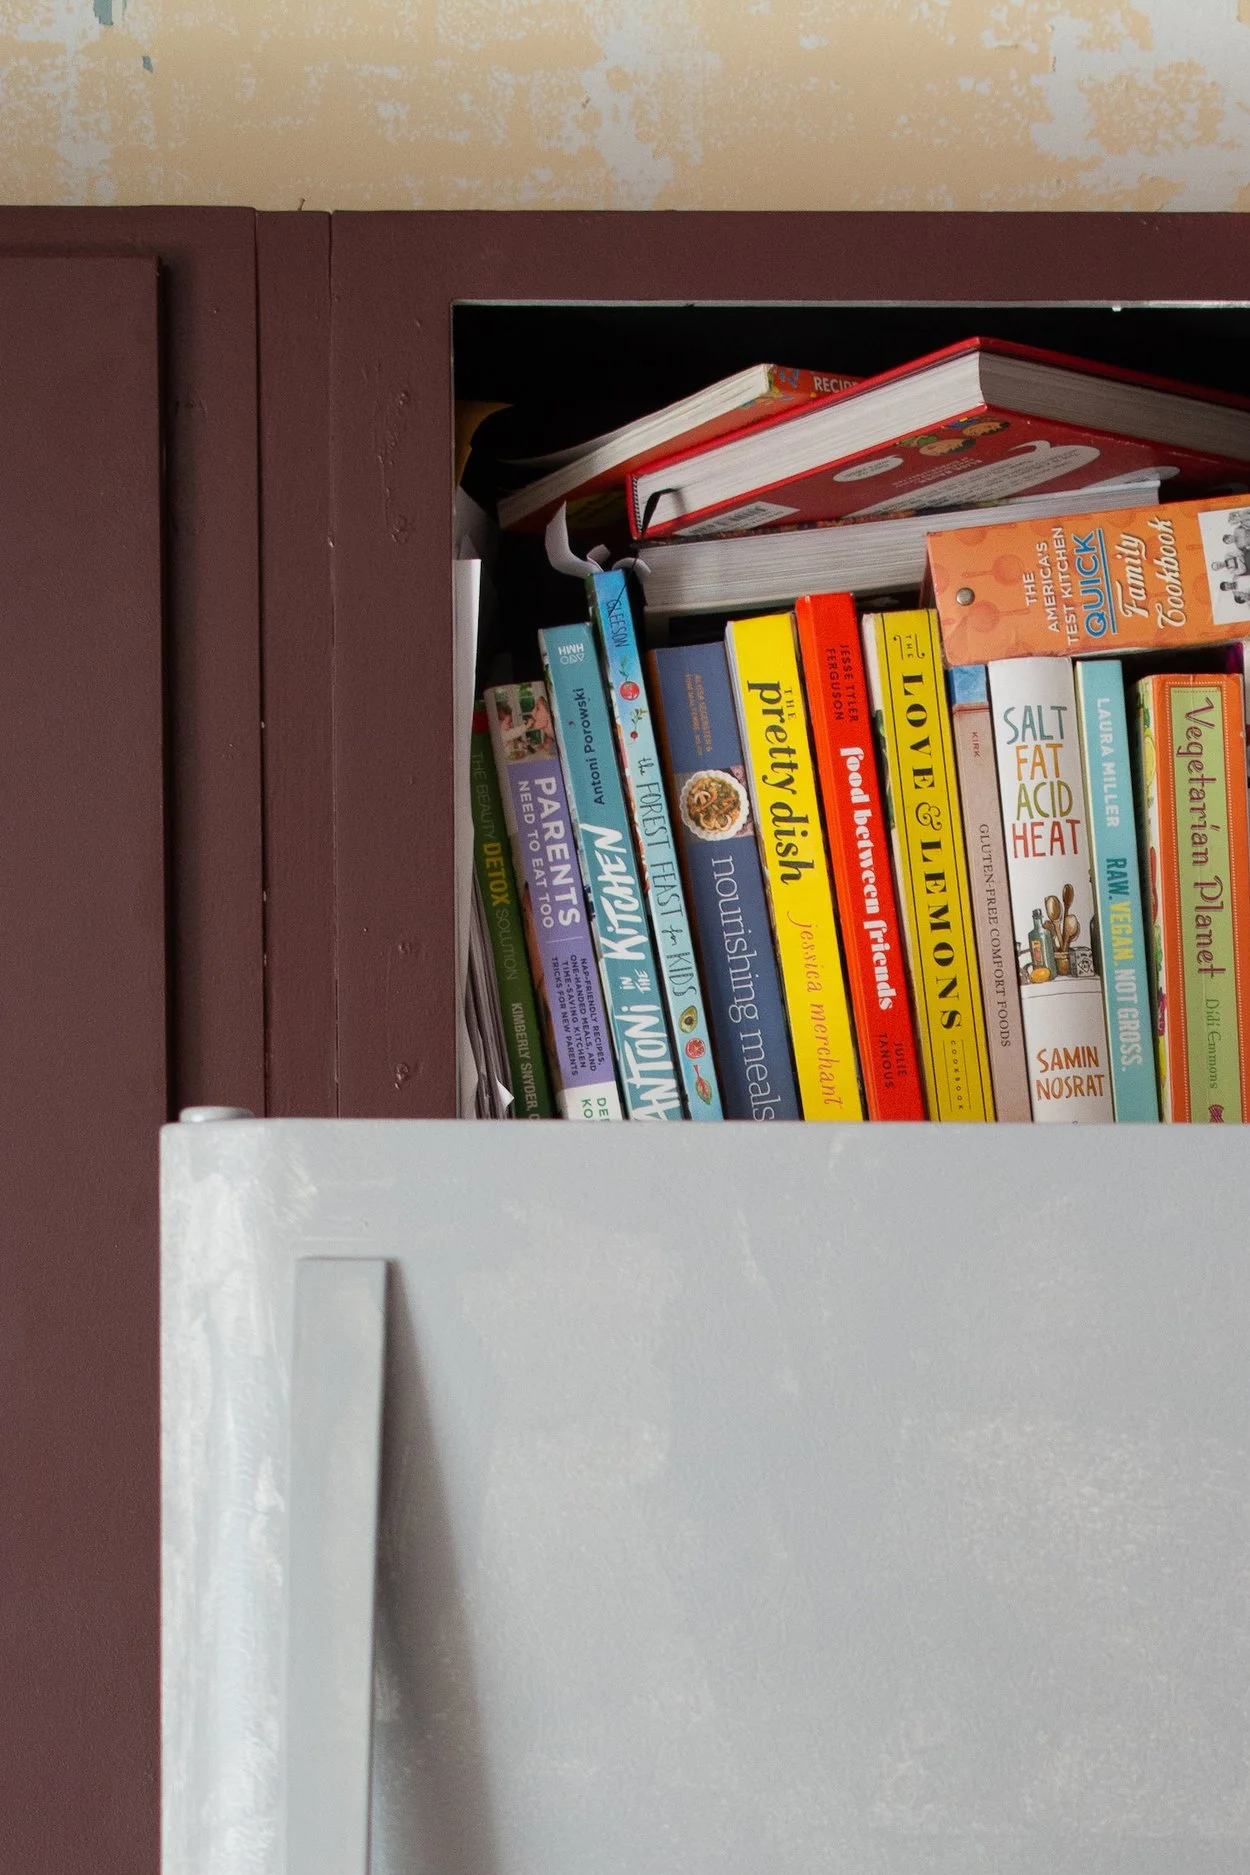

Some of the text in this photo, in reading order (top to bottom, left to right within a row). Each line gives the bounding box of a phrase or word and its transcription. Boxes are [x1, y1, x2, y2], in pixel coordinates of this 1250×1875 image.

[1022, 571, 1038, 607] THE
[1036, 540, 1060, 633] AMERICA'S
[1051, 526, 1080, 646] TEST KITCHEN
[1071, 531, 1109, 638] QUICK
[1115, 532, 1149, 619] Family
[1147, 516, 1187, 630] Cookbook
[558, 643, 585, 656] HMH
[606, 599, 630, 648] GLEESON
[905, 634, 914, 658] THE
[784, 687, 798, 720] THE
[825, 647, 844, 721] FERGUSON
[840, 644, 860, 722] JESSE TYLER
[1003, 705, 1068, 745] SALT
[572, 687, 605, 805] Antoni Porowski
[746, 680, 815, 885] pretty dish
[971, 731, 981, 758] KIRK
[1015, 743, 1064, 781] FAT
[1096, 697, 1121, 828] LAURA MILLER
[1012, 819, 1081, 859] HEAT
[1016, 780, 1073, 821] ACID
[1176, 696, 1227, 978] Vegetarian Planet
[471, 754, 518, 981] THE BEAUTY DETOX SOLUTION
[518, 780, 554, 929] NEED TO EAT TOO
[534, 776, 581, 926] PARENTS
[635, 758, 698, 997] the FOREST FEAST for KIDS
[839, 747, 898, 1010] food between friends
[902, 672, 963, 1030] LOVE & LEMONS
[634, 969, 652, 994] THE
[979, 823, 1011, 1048] GLUTEN-FREE COMFORT FOODS
[1106, 857, 1144, 1073] RAW. VEGAN. NOT GROSS.
[512, 1002, 532, 1058] KIMBERLY
[552, 956, 578, 1076] TRICKS FOR NEW PARENTS
[562, 960, 586, 1068] TIME-SAVING KITCHEN
[570, 954, 597, 1072] ONE-HANDED MEALS, AND
[581, 957, 605, 1065] NAP-FRIENDLY RECIPES,
[711, 855, 781, 1122] nourishing meals
[786, 911, 845, 1110] jessica merchant
[521, 1062, 538, 1112] SNYDER,
[879, 1033, 895, 1089] TANOUS
[894, 1042, 907, 1076] JULIE
[951, 1040, 964, 1110] COOKBOOK
[1035, 1074, 1105, 1101] NOSRAT
[1036, 1046, 1100, 1074] SAMIN
[1205, 998, 1222, 1090] Didi Emmons
